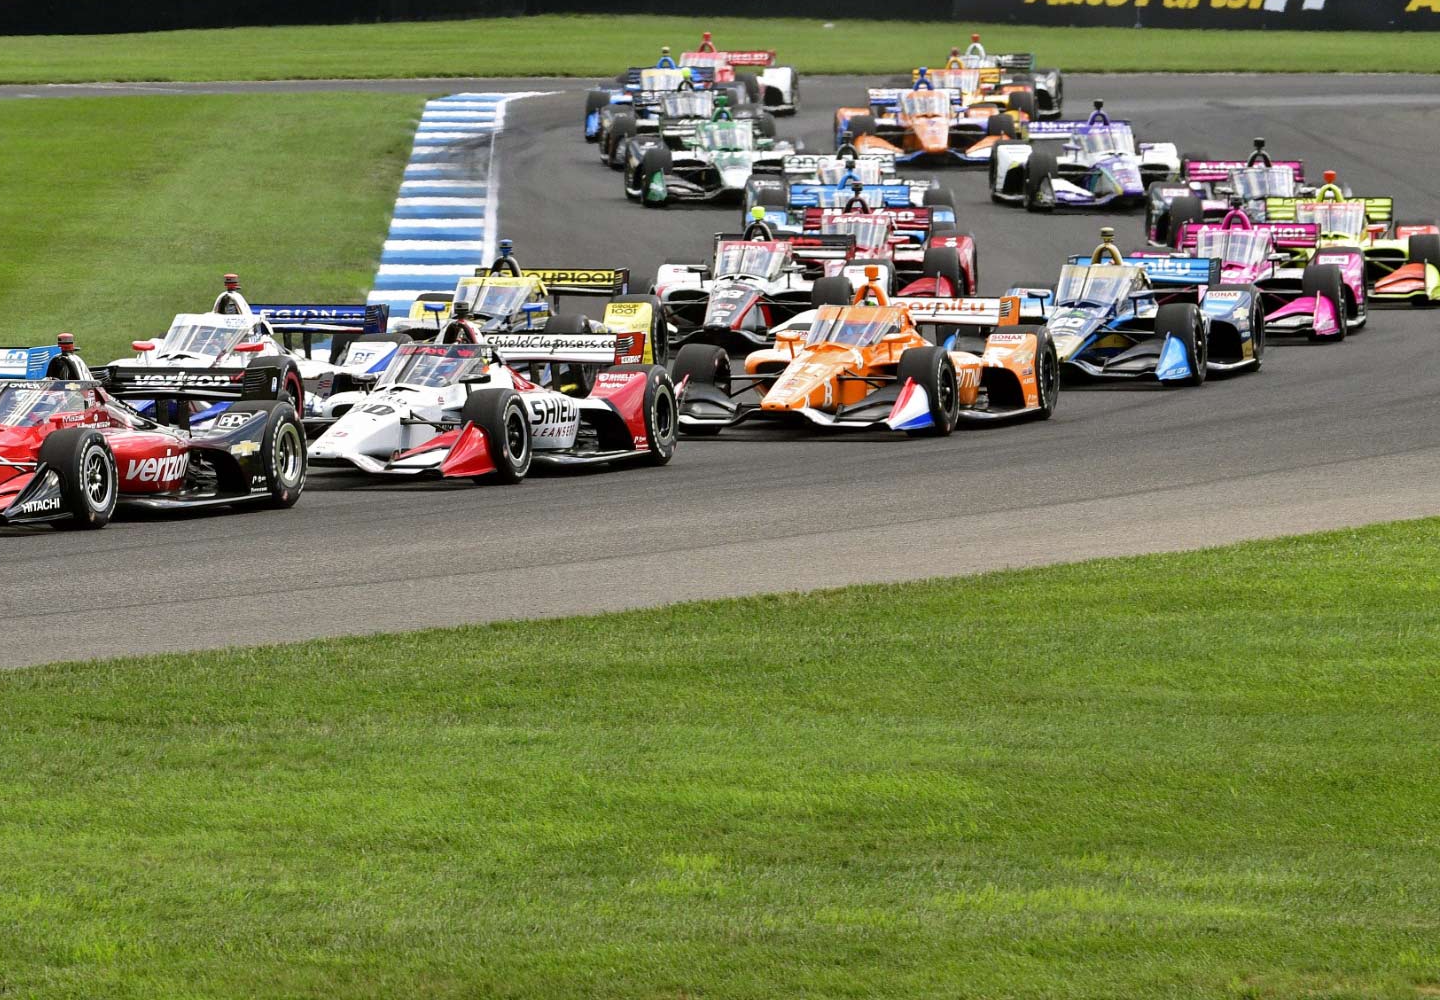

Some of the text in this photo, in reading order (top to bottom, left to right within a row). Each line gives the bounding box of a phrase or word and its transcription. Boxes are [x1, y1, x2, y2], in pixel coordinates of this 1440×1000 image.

[133, 371, 231, 387] verizon
[125, 448, 190, 482] verizon
[21, 497, 60, 513] HITACHI
